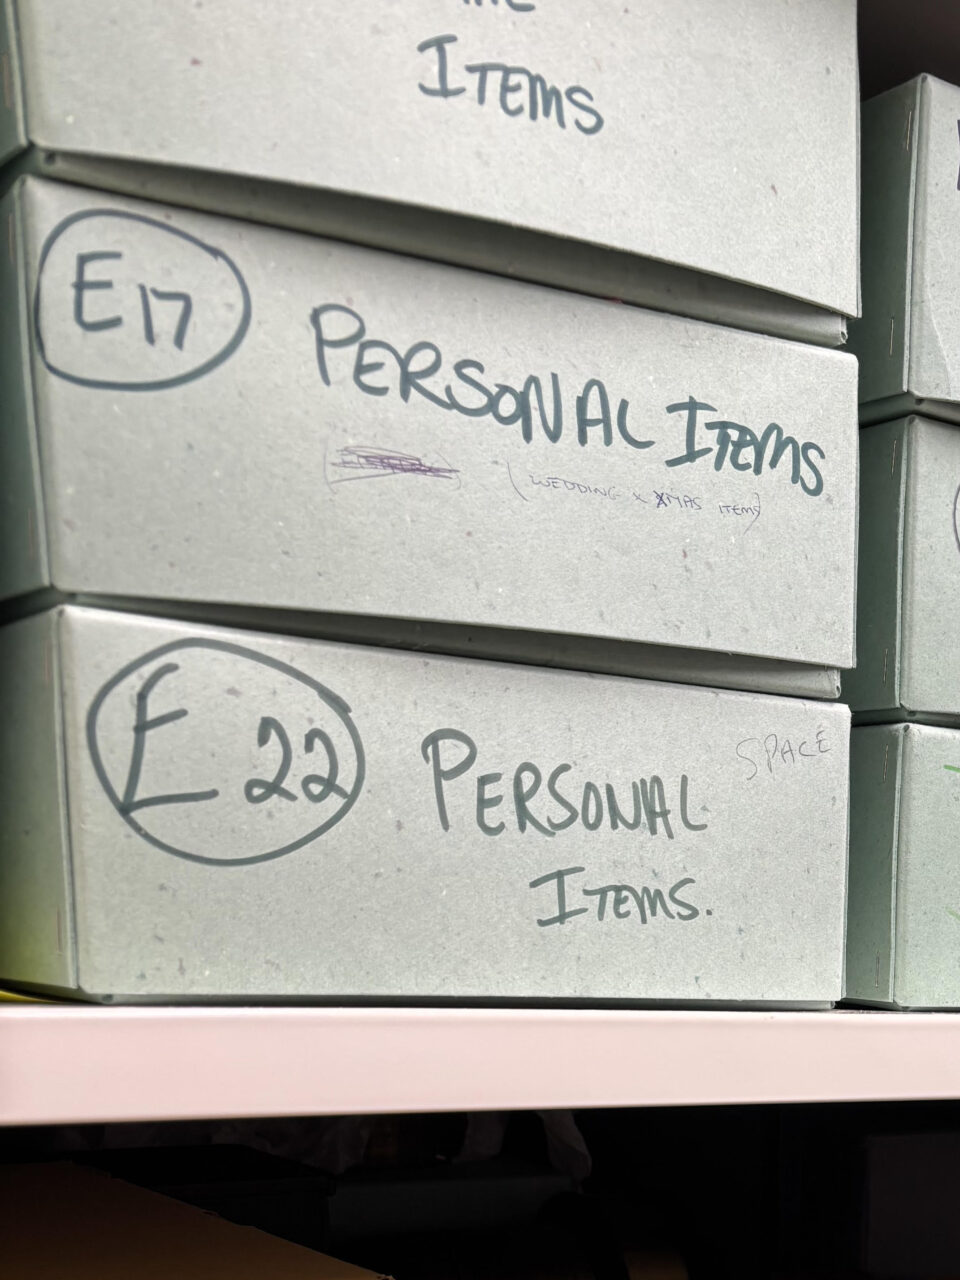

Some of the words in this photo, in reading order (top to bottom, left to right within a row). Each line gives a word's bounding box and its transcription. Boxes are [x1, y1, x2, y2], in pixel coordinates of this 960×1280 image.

[418, 34, 604, 134] ITEMS
[72, 251, 193, 350] E17
[311, 303, 656, 450] PERSONAL
[665, 396, 825, 495] ITEMS
[421, 728, 707, 837] PERSONAL
[735, 731, 833, 783] SPACE
